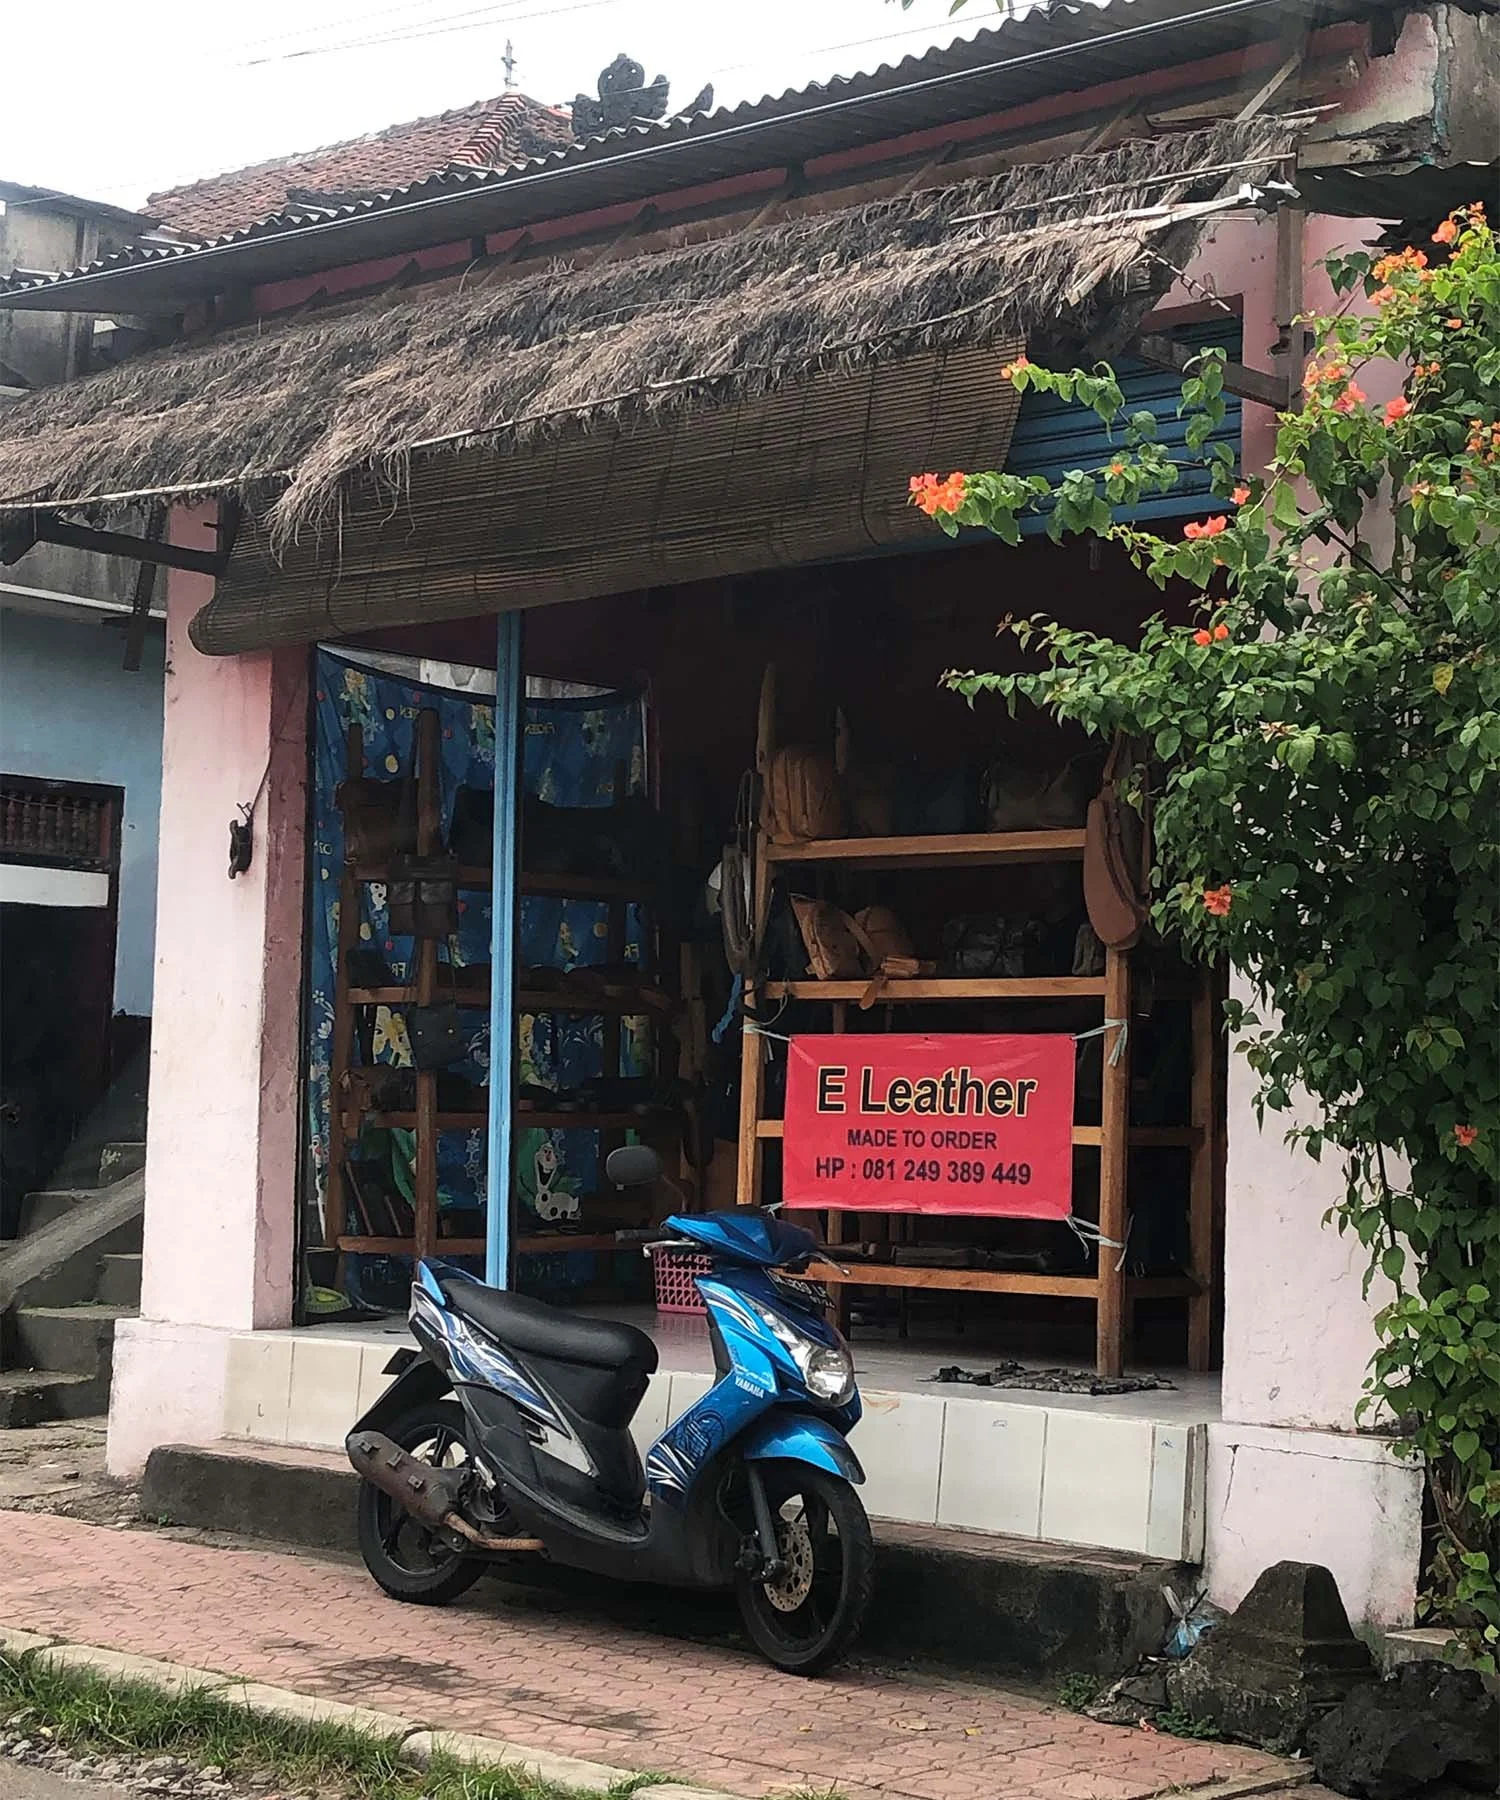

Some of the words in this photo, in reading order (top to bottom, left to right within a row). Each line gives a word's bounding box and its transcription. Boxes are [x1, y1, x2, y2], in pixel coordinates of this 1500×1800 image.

[816, 1065, 847, 1114] E
[860, 1066, 1038, 1117] Leather
[847, 1129, 897, 1148] MADE
[902, 1130, 924, 1148] TO
[930, 1131, 997, 1150] ORDER
[815, 1157, 844, 1179] HP
[863, 1158, 895, 1181] 081
[904, 1159, 941, 1183] 249
[947, 1161, 985, 1184] 389
[991, 1163, 1031, 1186] 449
[735, 1375, 765, 1399] YAMAHA
